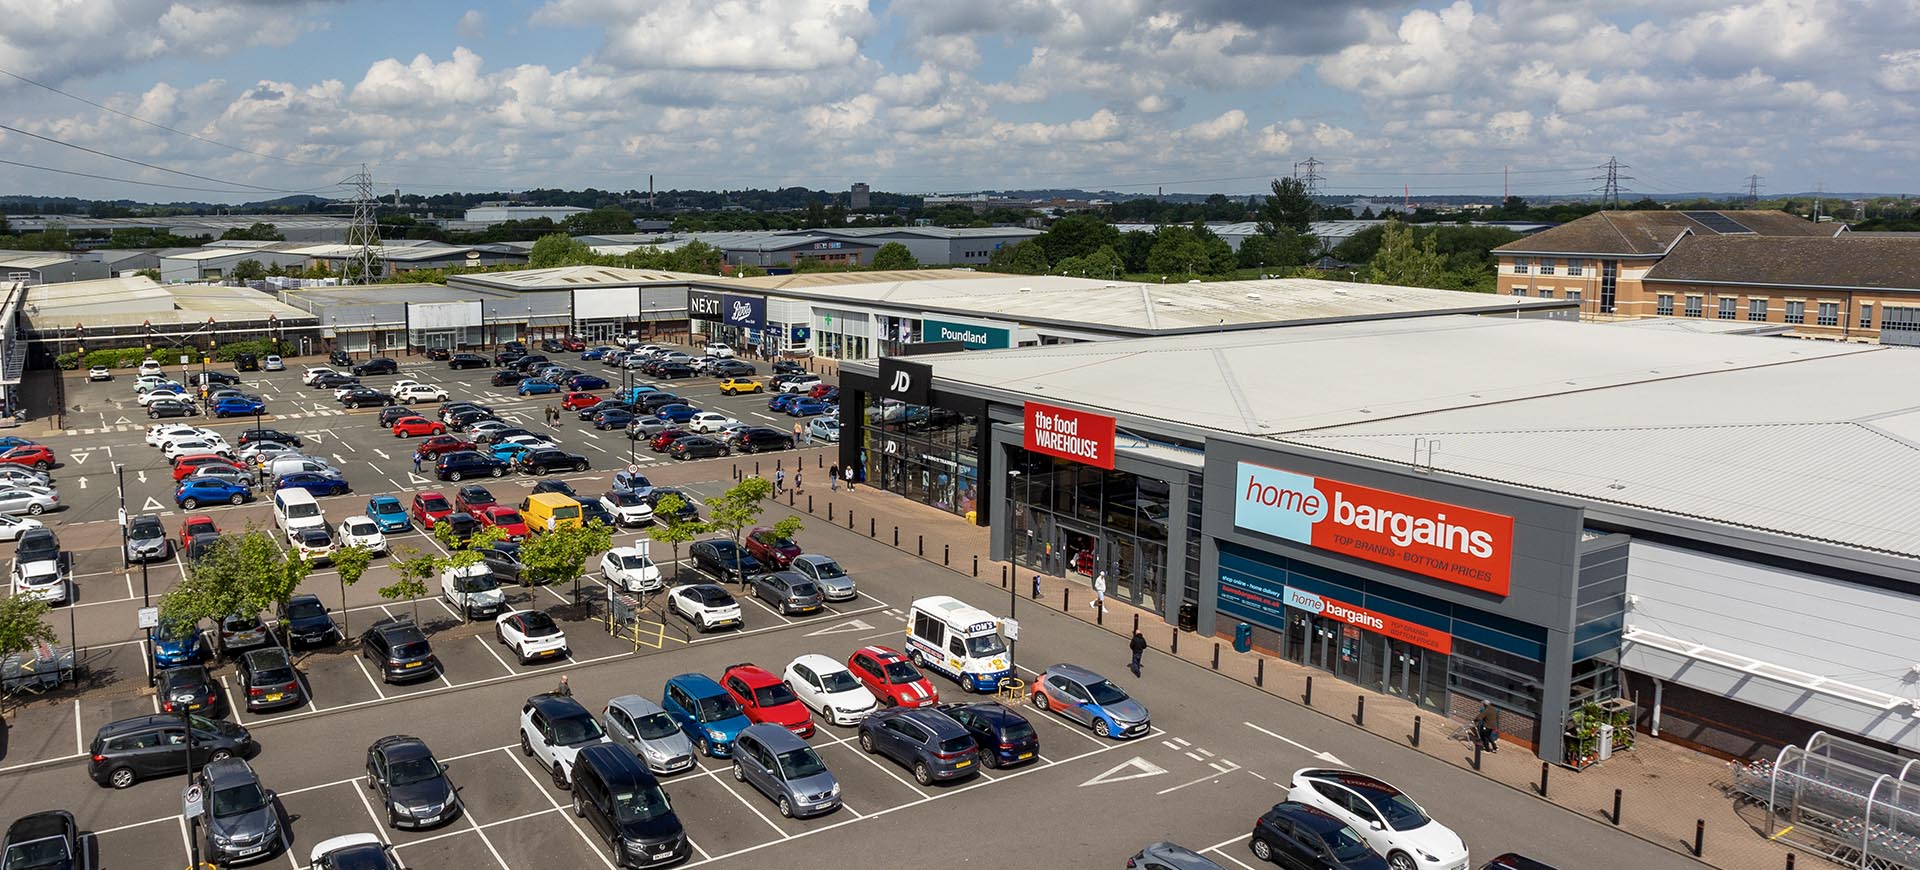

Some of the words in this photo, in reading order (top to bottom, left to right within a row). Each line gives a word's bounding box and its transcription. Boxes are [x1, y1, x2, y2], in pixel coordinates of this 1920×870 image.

[691, 297, 720, 315] NEXT
[732, 301, 752, 321] Boots
[941, 327, 987, 344] Poundland
[890, 370, 910, 393] JD
[1035, 411, 1052, 431] the
[1053, 414, 1078, 436] food
[884, 440, 897, 454] JD
[1035, 428, 1098, 459] WAREHOUSE
[1245, 475, 1320, 517] home
[1333, 491, 1495, 558] bargains
[1333, 534, 1353, 546] TOP
[1354, 540, 1395, 558] BRANDS
[1402, 552, 1449, 572] BOTTOM
[1450, 564, 1493, 582] PRICES
[1291, 592, 1322, 610] home
[1326, 600, 1384, 630] bargains
[970, 621, 994, 632] TOM'S
